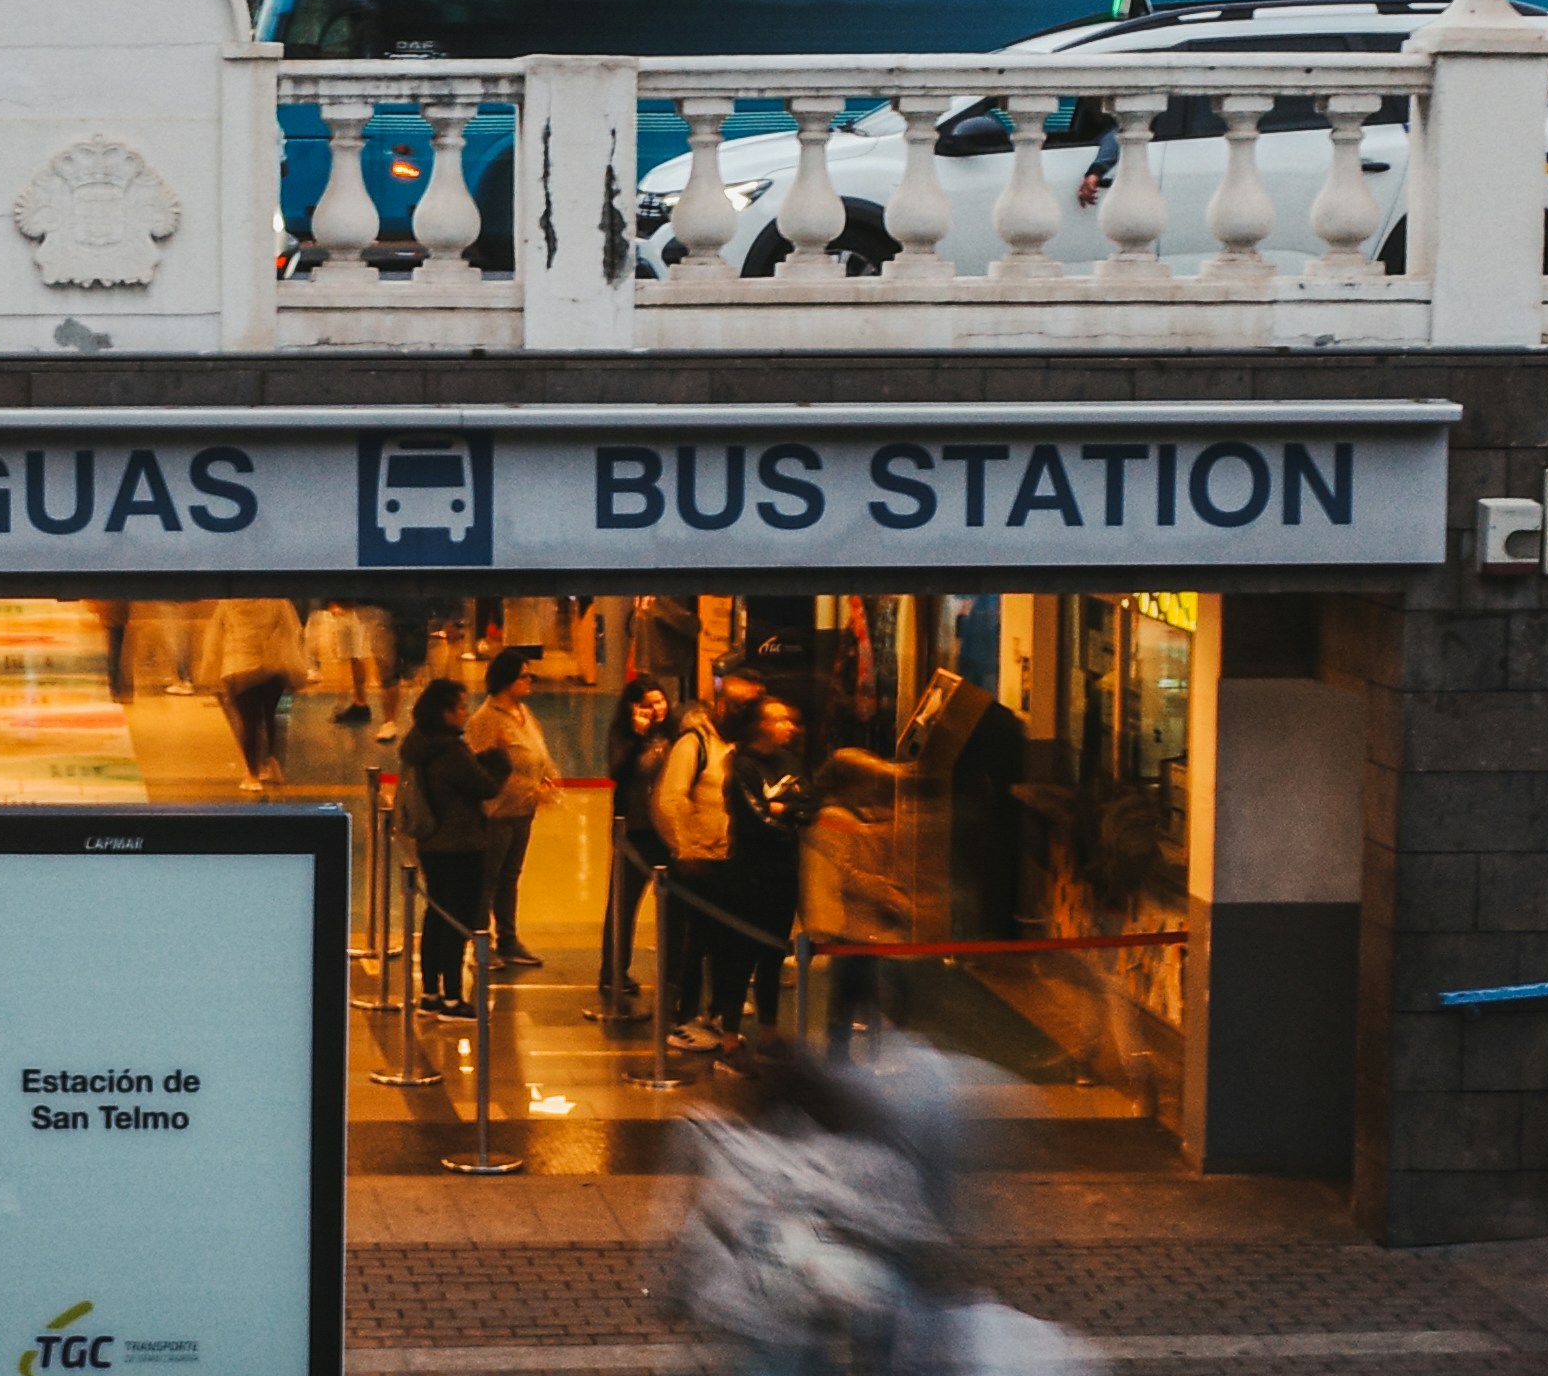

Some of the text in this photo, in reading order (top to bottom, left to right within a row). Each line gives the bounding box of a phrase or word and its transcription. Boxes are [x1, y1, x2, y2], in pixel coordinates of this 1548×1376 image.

[595, 440, 1356, 532] BUS STATION
[21, 1066, 202, 1095] Estación de
[31, 1103, 191, 1132] San Telmo
[35, 1335, 115, 1369] TGC
[124, 1340, 200, 1352] TRANSPORTE
